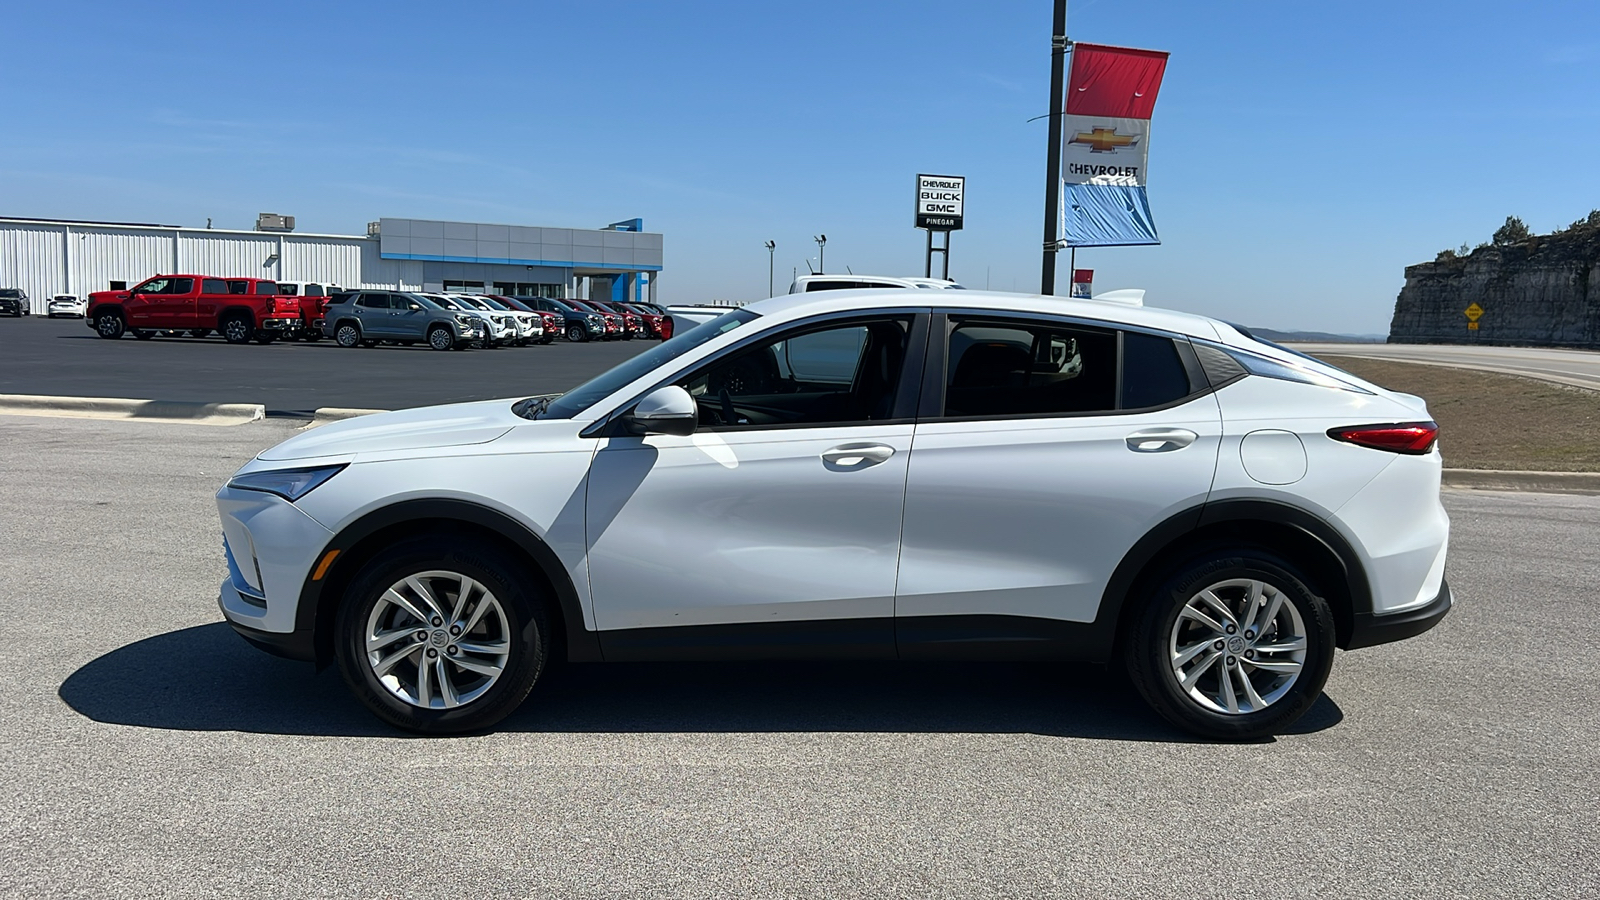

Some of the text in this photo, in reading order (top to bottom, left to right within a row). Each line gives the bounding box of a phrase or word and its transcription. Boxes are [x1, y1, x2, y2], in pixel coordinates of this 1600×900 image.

[1069, 162, 1138, 177] CHEVROLET
[922, 180, 961, 189] CHEVROLET
[921, 191, 961, 201] BUICK
[926, 203, 955, 213] GMC
[926, 217, 954, 226] PINEGAR
